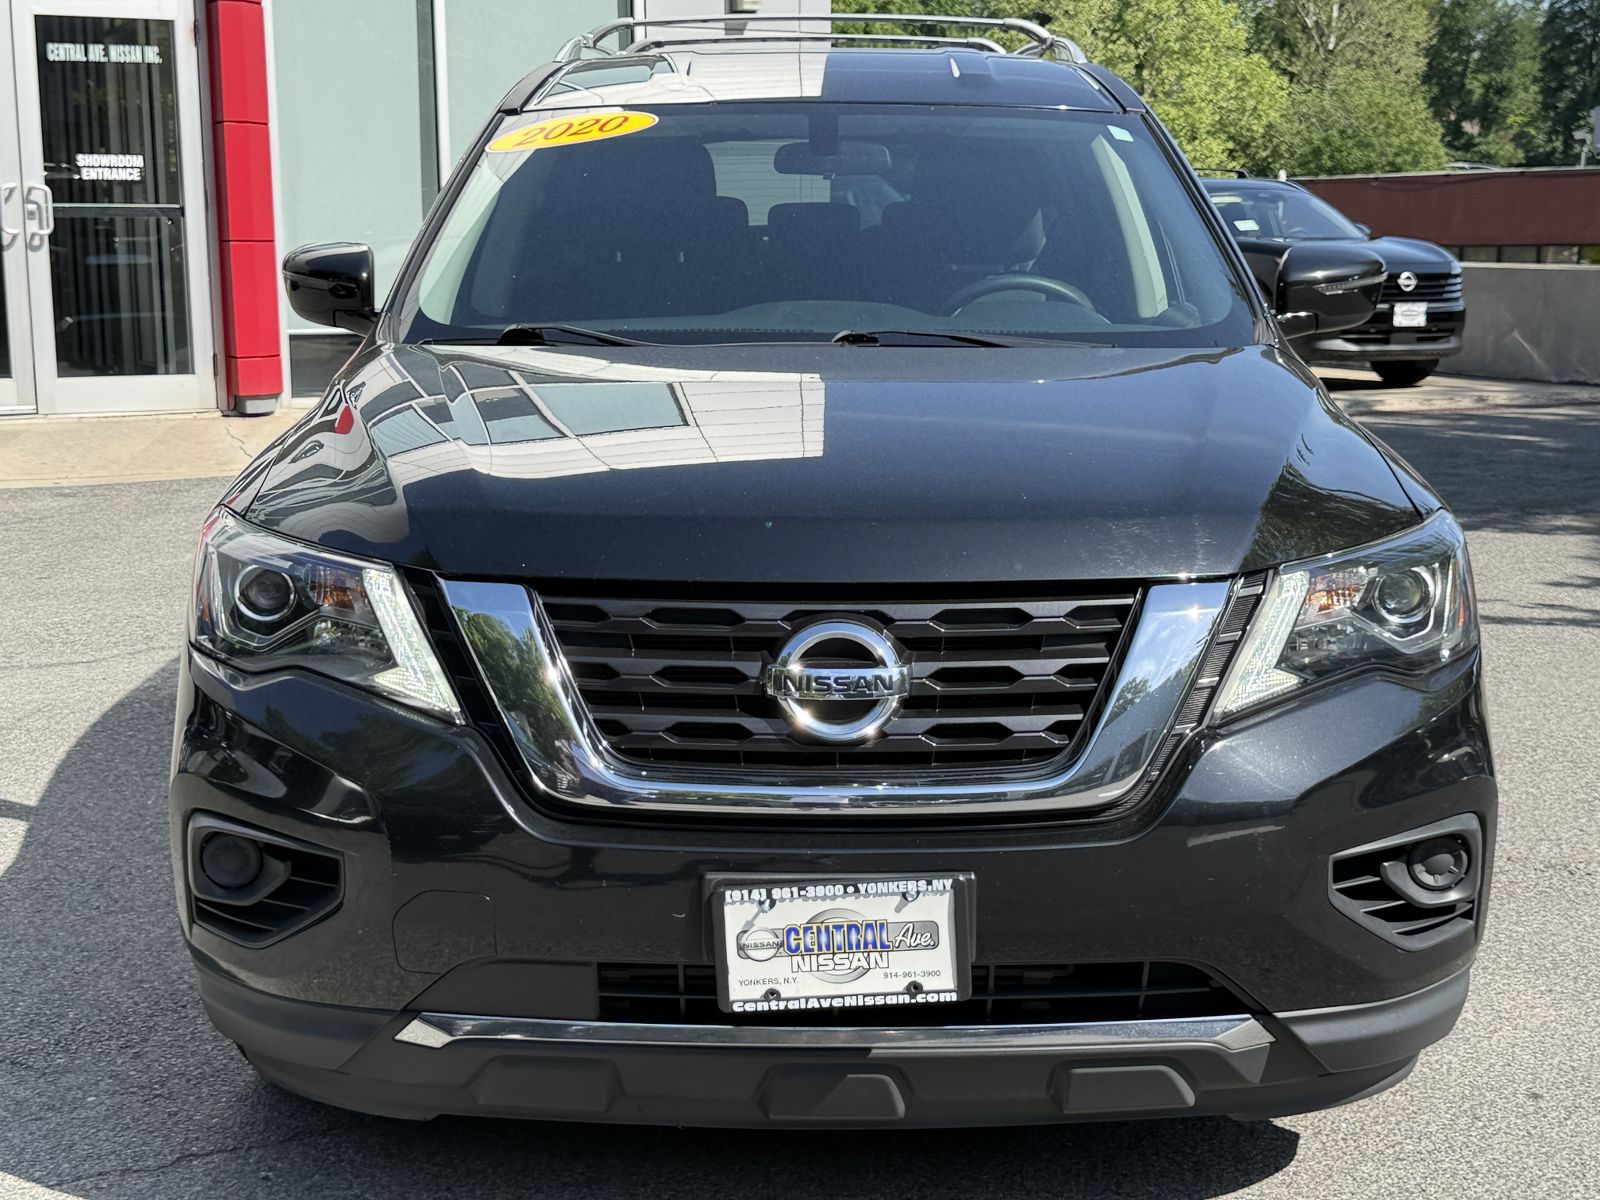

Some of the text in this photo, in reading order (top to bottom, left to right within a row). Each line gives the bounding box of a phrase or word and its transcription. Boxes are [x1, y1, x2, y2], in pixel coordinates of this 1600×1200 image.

[46, 42, 163, 65] CENTRAL AVE. NISSAN INC.
[512, 115, 630, 148] 2020
[75, 153, 144, 168] SHOWROOM
[80, 167, 141, 181] ENTRANCE
[782, 674, 894, 694] NISSAN
[771, 884, 844, 900] 961-3900
[742, 940, 779, 949] NISSAN
[783, 919, 936, 955] CENTRAL Ave.
[790, 952, 890, 973] NISSAN
[738, 976, 800, 987] YONKERS, N.Y.
[883, 970, 941, 980] 914-961-3900
[732, 991, 958, 1012] CentralAveNissan.com
